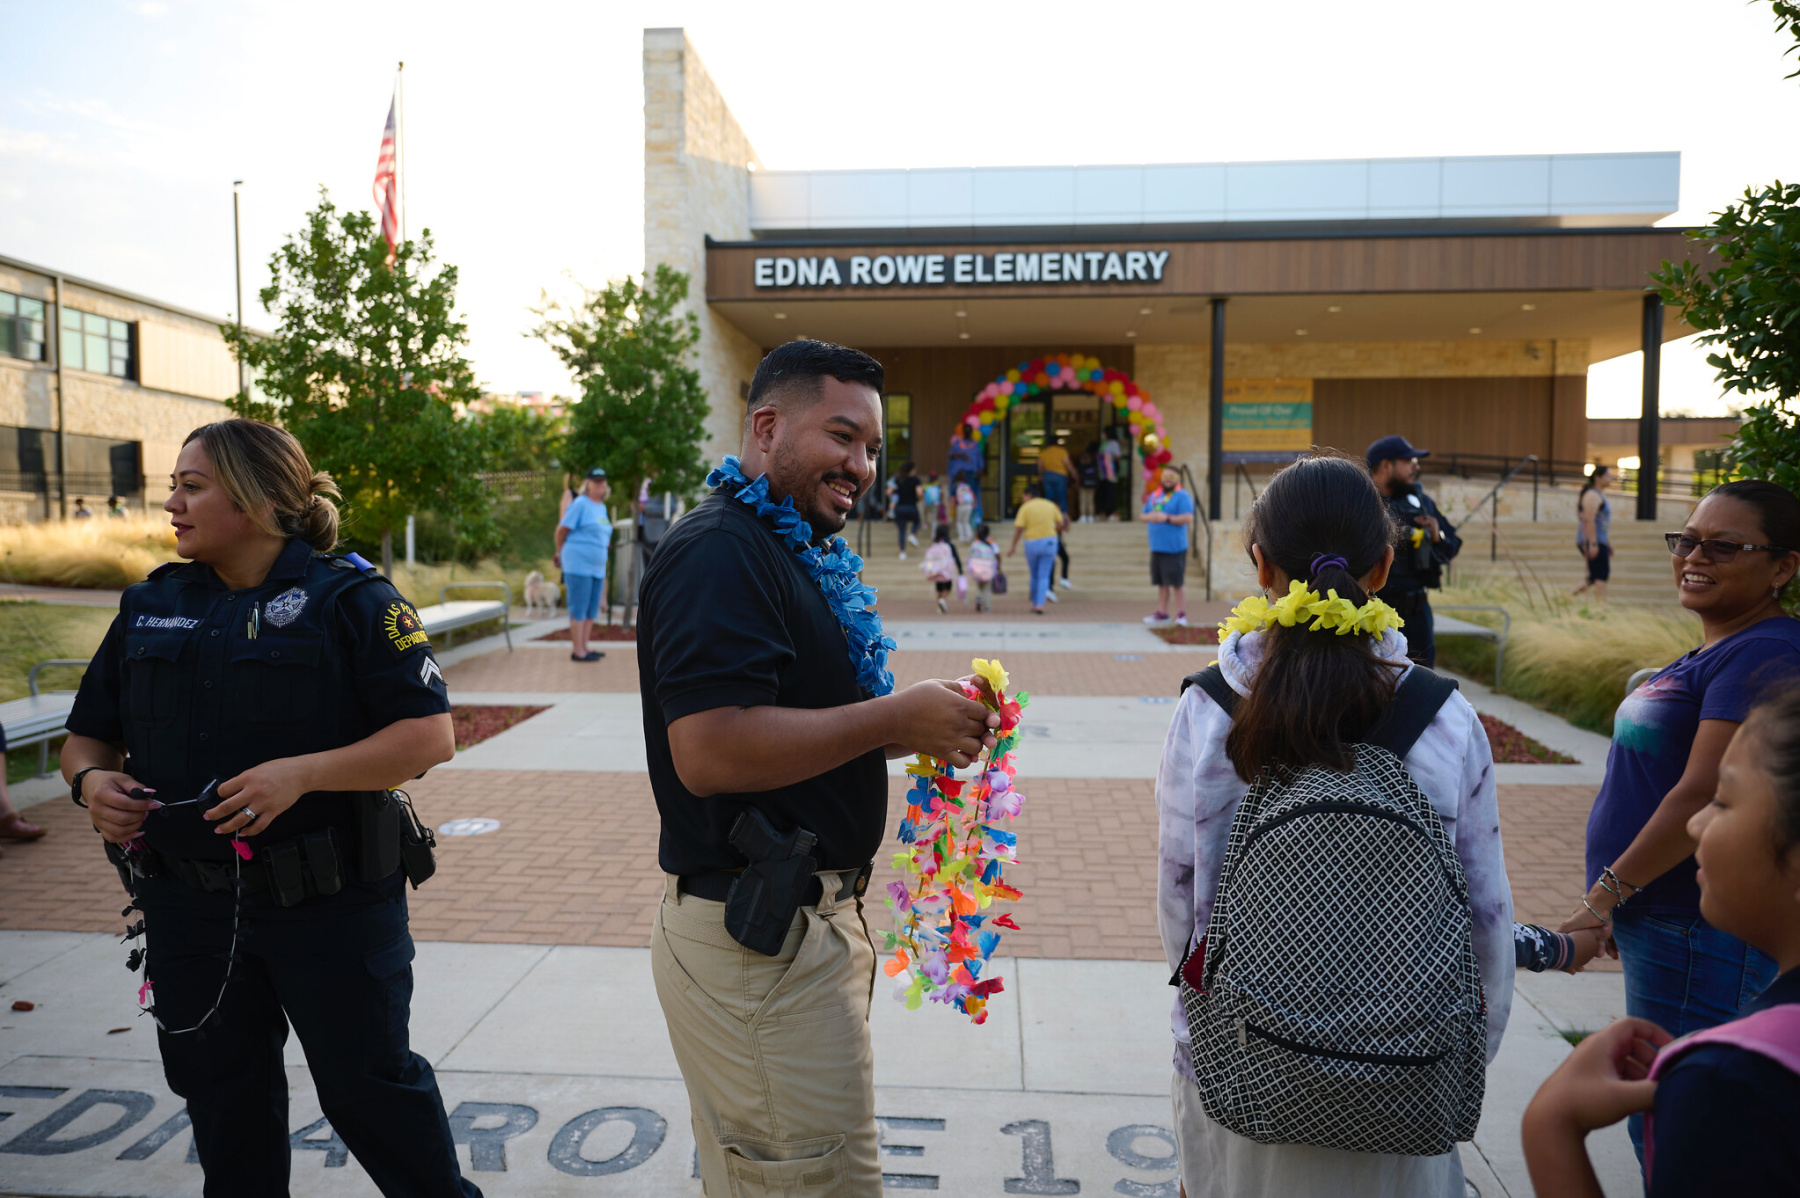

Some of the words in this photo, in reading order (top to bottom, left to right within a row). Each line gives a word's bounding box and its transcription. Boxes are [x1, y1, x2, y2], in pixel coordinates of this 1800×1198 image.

[755, 256, 842, 286] EDNA
[850, 253, 945, 285] ROWE
[954, 250, 1170, 283] ELEMENTARY
[144, 615, 199, 630] HERNANDEZ
[384, 603, 401, 640] DALLAS
[400, 602, 424, 629] POLICE
[449, 1101, 946, 1190] ROE
